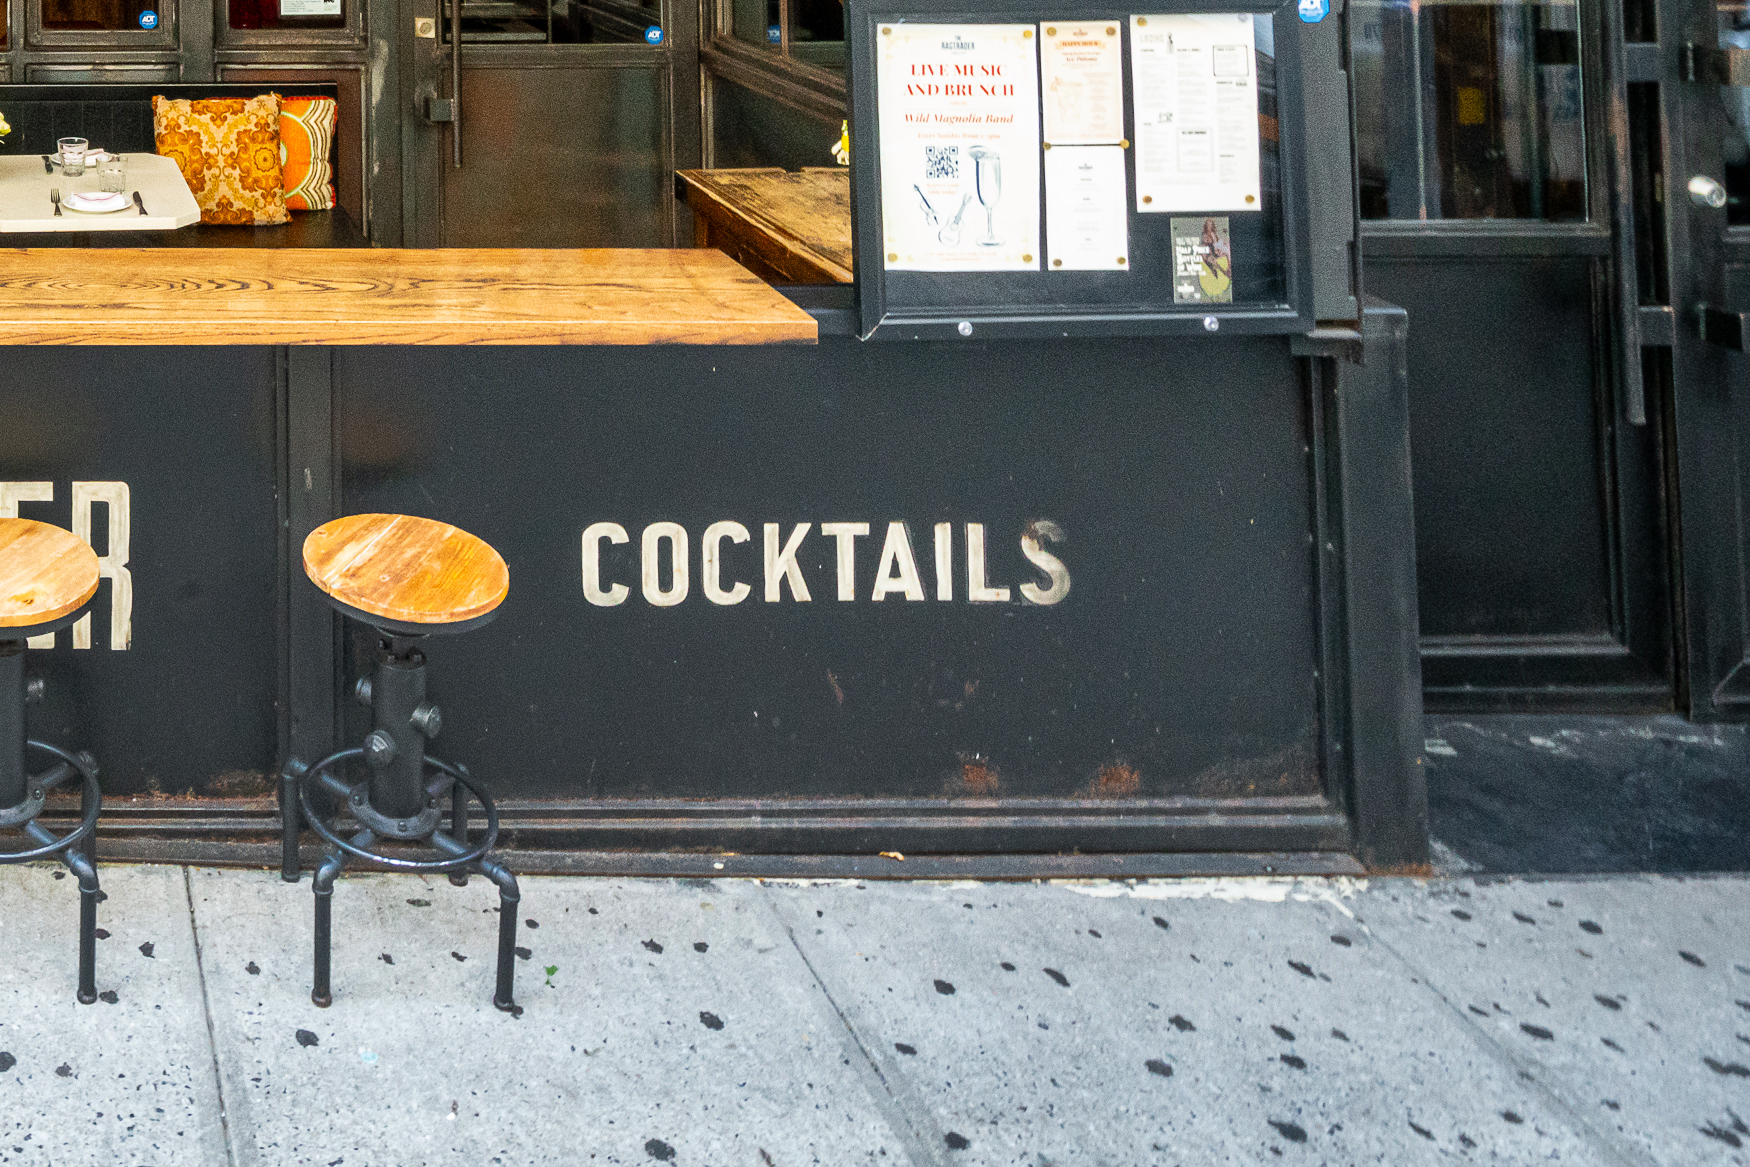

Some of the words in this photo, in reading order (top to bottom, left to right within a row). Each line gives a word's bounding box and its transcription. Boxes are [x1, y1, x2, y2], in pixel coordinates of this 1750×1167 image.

[910, 64, 949, 77] LIVE
[953, 64, 1008, 77] MUSIC
[903, 83, 940, 97] AND
[944, 83, 1015, 97] BRUNCH
[904, 113, 930, 123] Wild
[933, 113, 983, 125] Magnolia
[985, 114, 1014, 124] Band
[581, 520, 1072, 608] COCKTAILS
